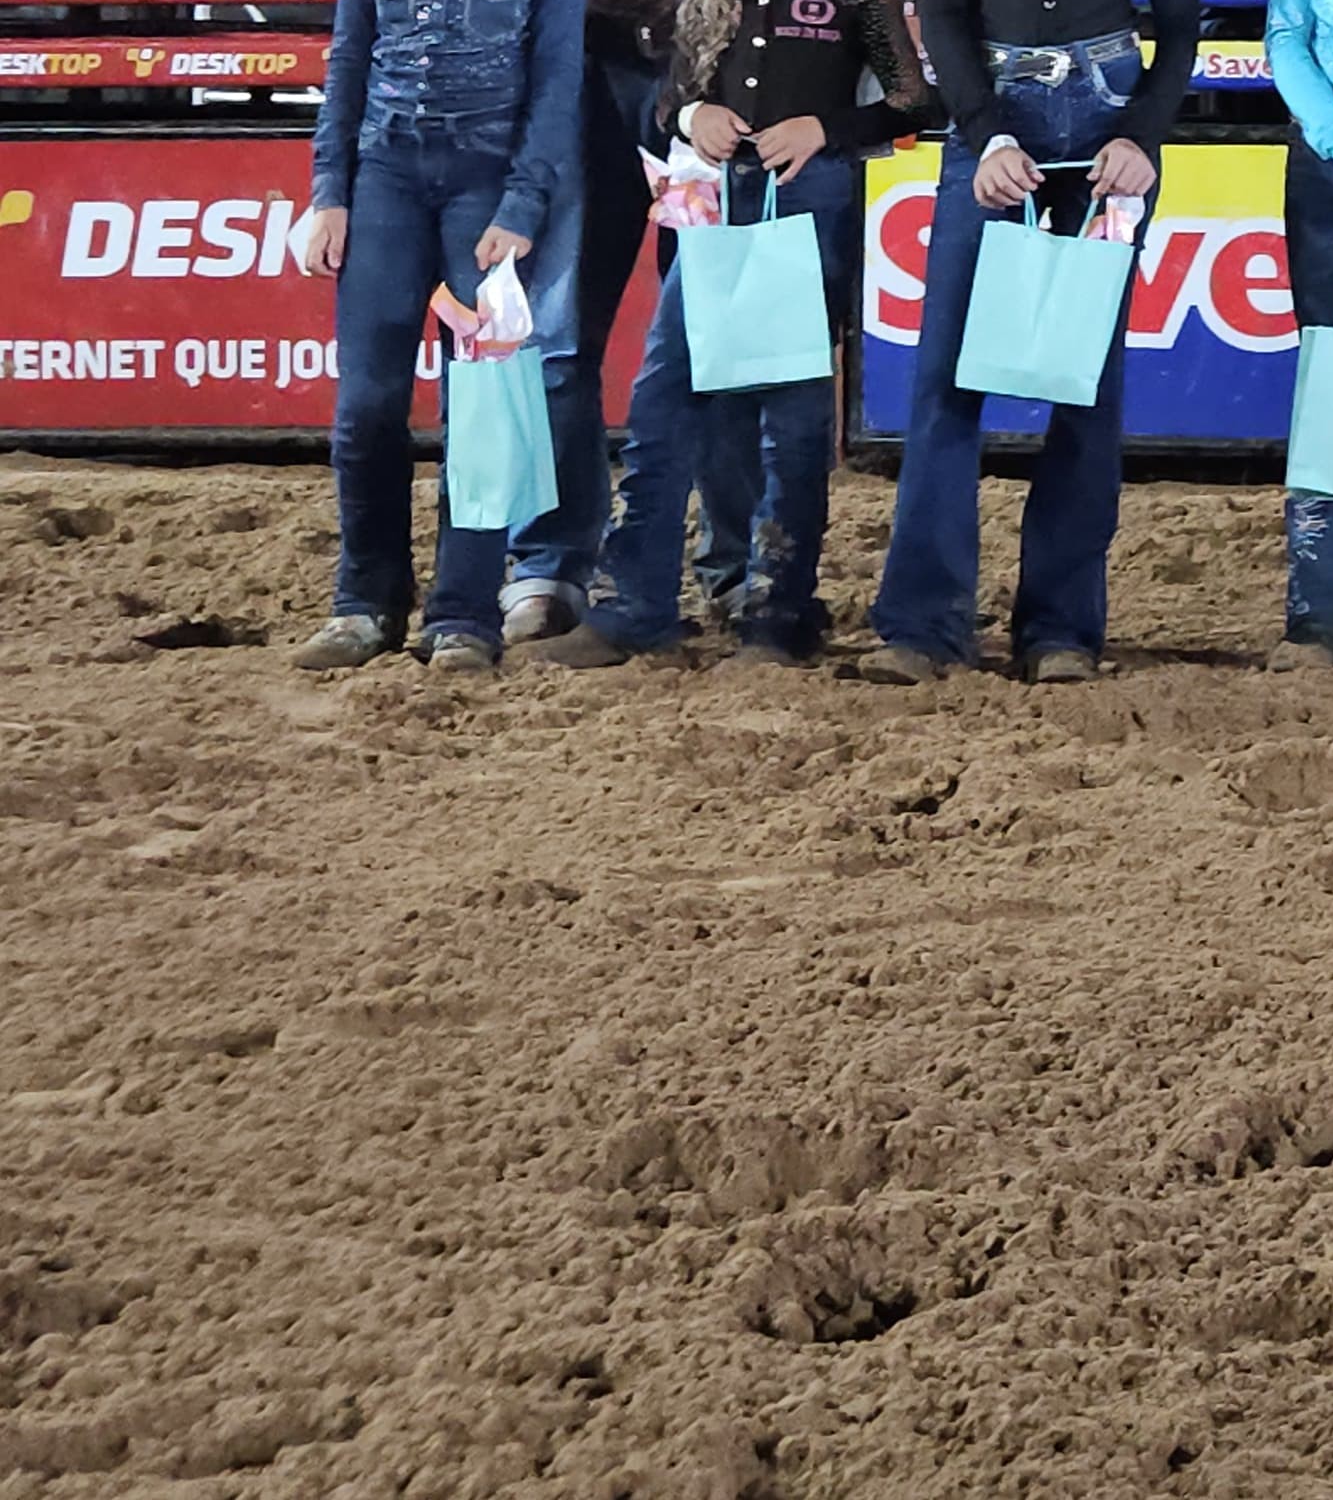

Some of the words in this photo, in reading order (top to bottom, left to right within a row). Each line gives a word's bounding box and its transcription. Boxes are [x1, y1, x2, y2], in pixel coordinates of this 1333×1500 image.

[0, 54, 101, 75] ESKTOP
[170, 54, 297, 75] DESKTOP
[61, 200, 313, 277] DESK
[175, 340, 268, 388] QUE
